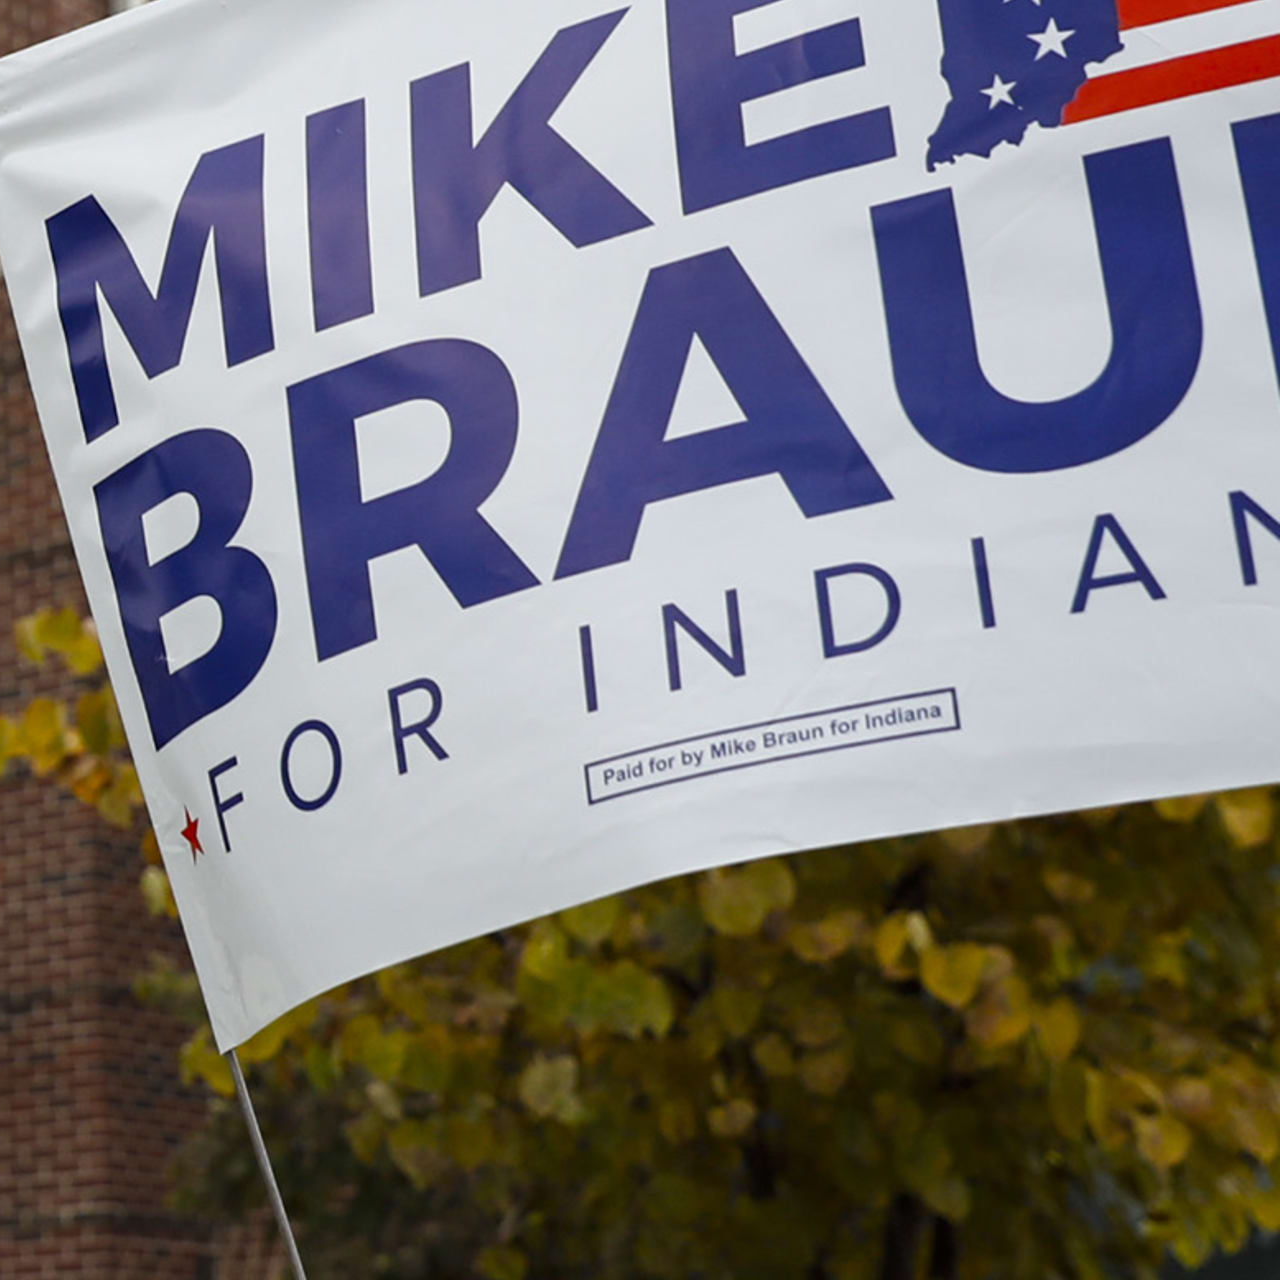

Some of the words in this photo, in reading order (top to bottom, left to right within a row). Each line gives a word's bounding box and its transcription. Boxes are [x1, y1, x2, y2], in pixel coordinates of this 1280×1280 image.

[92, 111, 1280, 753] BRAU
[208, 676, 451, 854] FOR
[603, 763, 644, 786] Paid
[648, 756, 676, 775] for
[680, 750, 705, 767] by
[710, 737, 757, 760] Mike
[762, 725, 824, 749] Braun
[830, 718, 858, 735] for
[865, 703, 942, 730] Indiana
